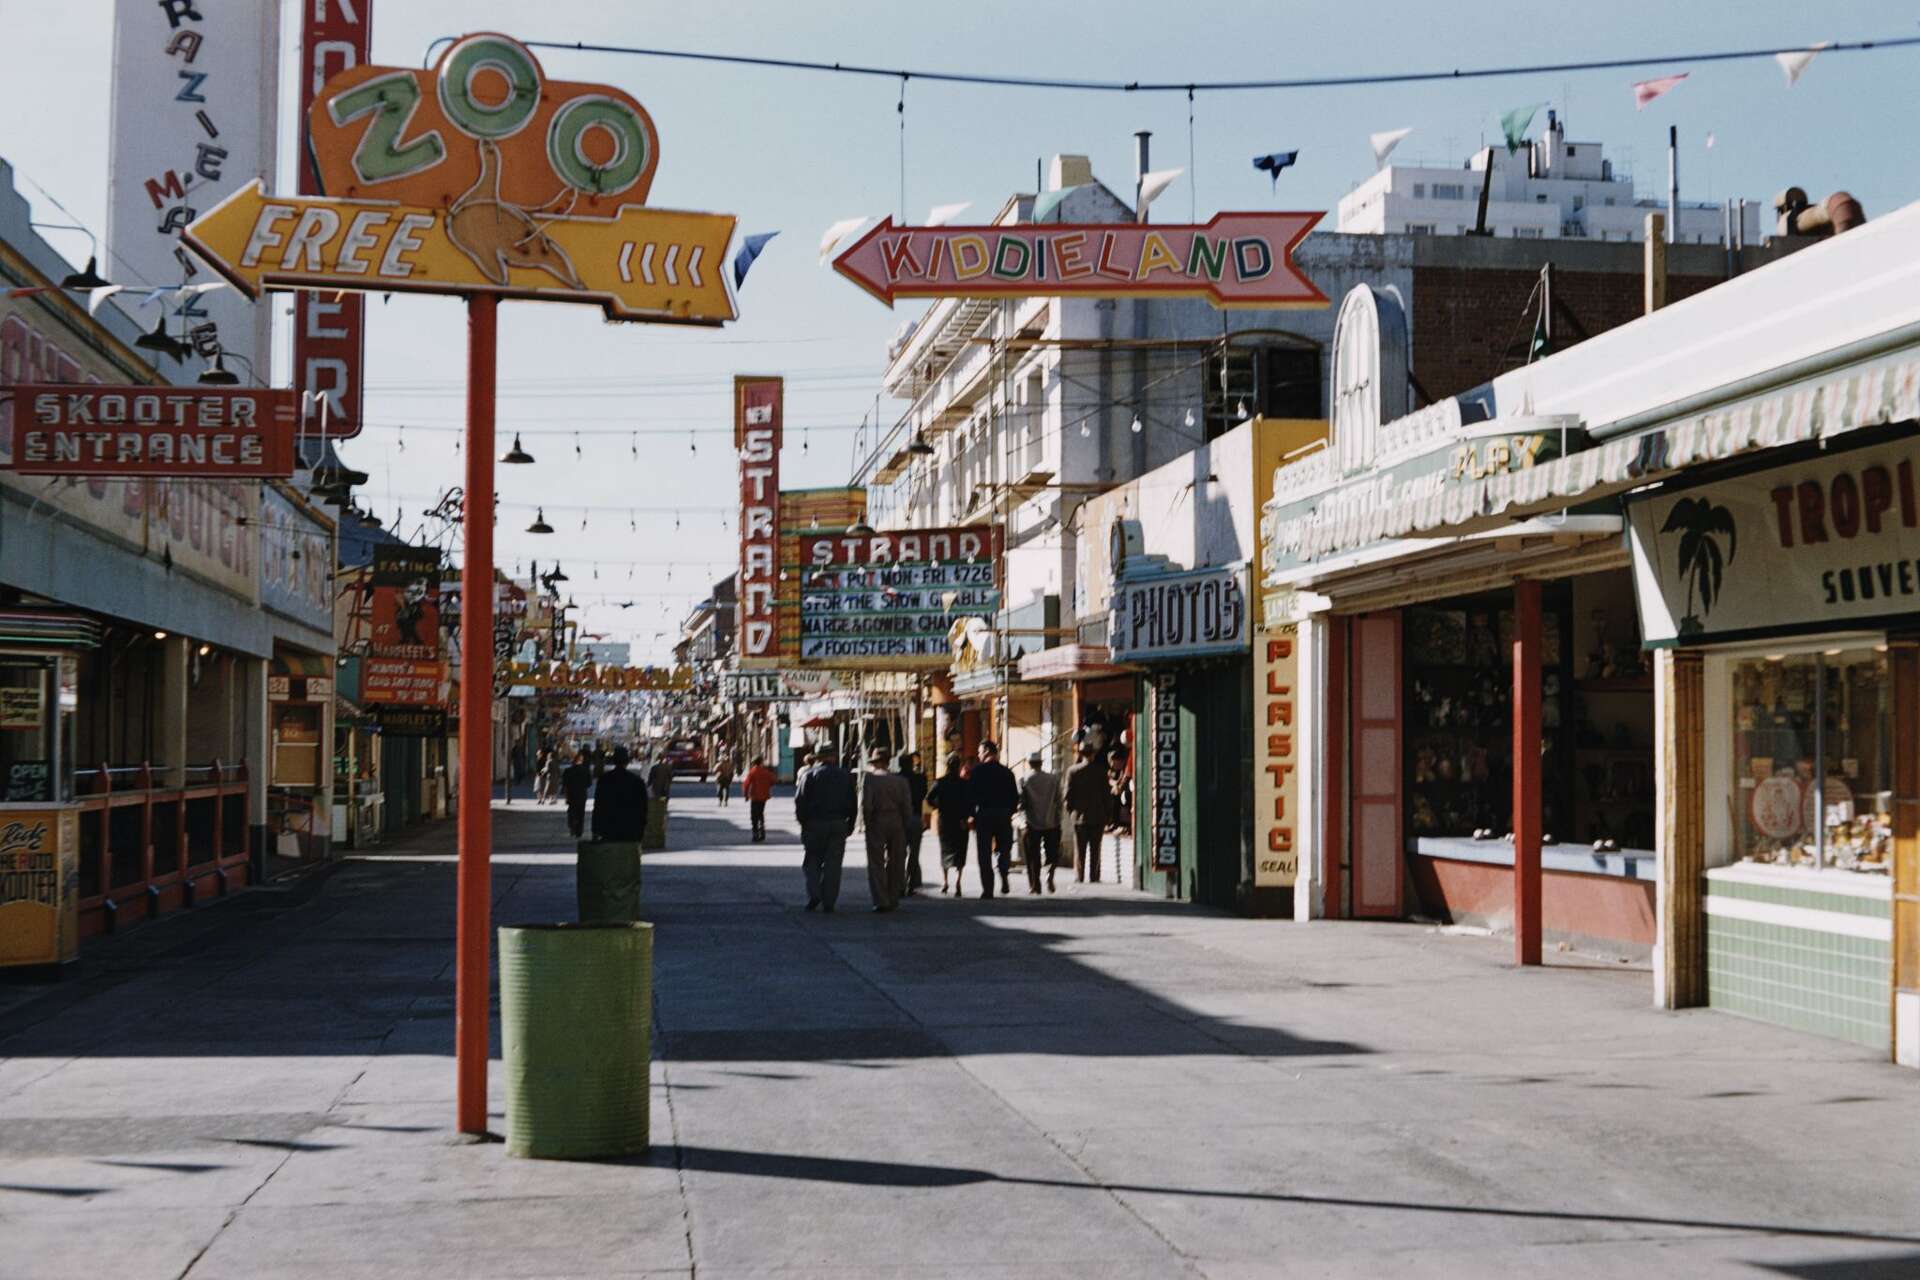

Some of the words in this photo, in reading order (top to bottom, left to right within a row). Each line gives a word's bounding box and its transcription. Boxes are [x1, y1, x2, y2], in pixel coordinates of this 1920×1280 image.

[327, 33, 652, 197] ZOO
[240, 204, 434, 277] FREE
[880, 230, 1272, 284] KIDDIELAND
[34, 393, 257, 428] SKOOTER
[24, 431, 263, 465] ENTRANCE
[1771, 458, 1917, 548] TROPI
[744, 429, 773, 654] STRAND
[812, 532, 982, 566] STRAND
[930, 590, 987, 607] GABLE
[1822, 560, 1920, 604] SOUVE
[1131, 575, 1241, 650] PHOTOS
[825, 639, 906, 655] FOOTSTEPS
[912, 638, 926, 654] IN
[930, 637, 950, 653] TH
[726, 675, 774, 697] BALL
[1157, 674, 1177, 865] PHOTOSTATS
[1265, 639, 1294, 852] PLASTIC
